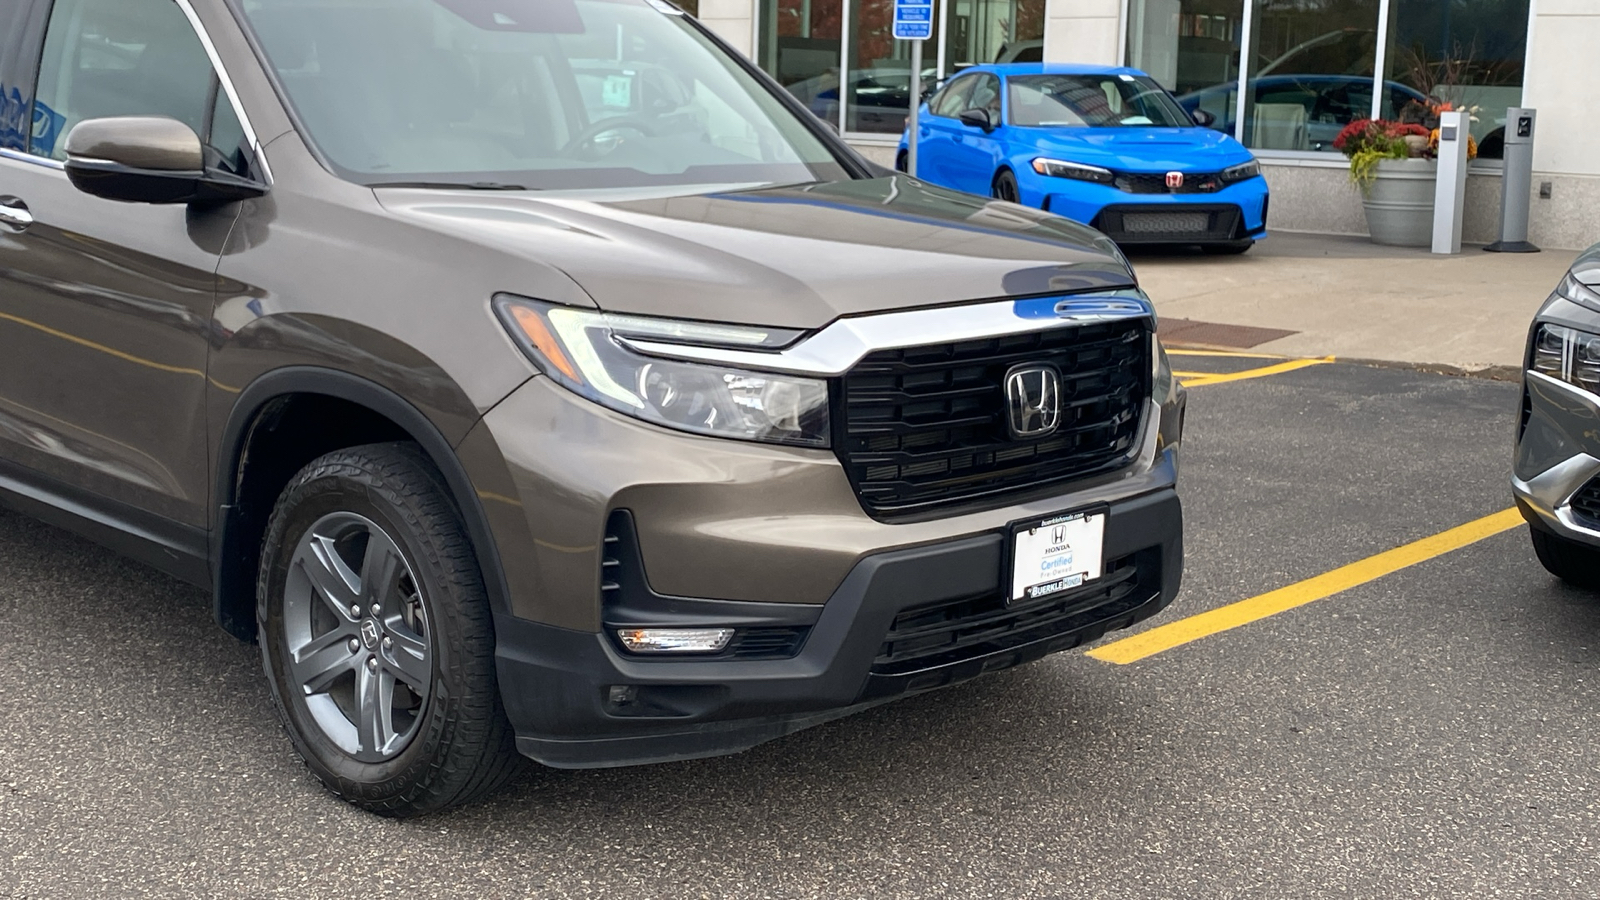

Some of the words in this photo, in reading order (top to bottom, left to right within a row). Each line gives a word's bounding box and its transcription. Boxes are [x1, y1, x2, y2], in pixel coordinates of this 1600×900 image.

[1045, 543, 1070, 554] HONDA
[1041, 554, 1073, 571] Certified
[1040, 566, 1072, 578] Pre-Owned
[1032, 581, 1063, 597] BUERKLE
